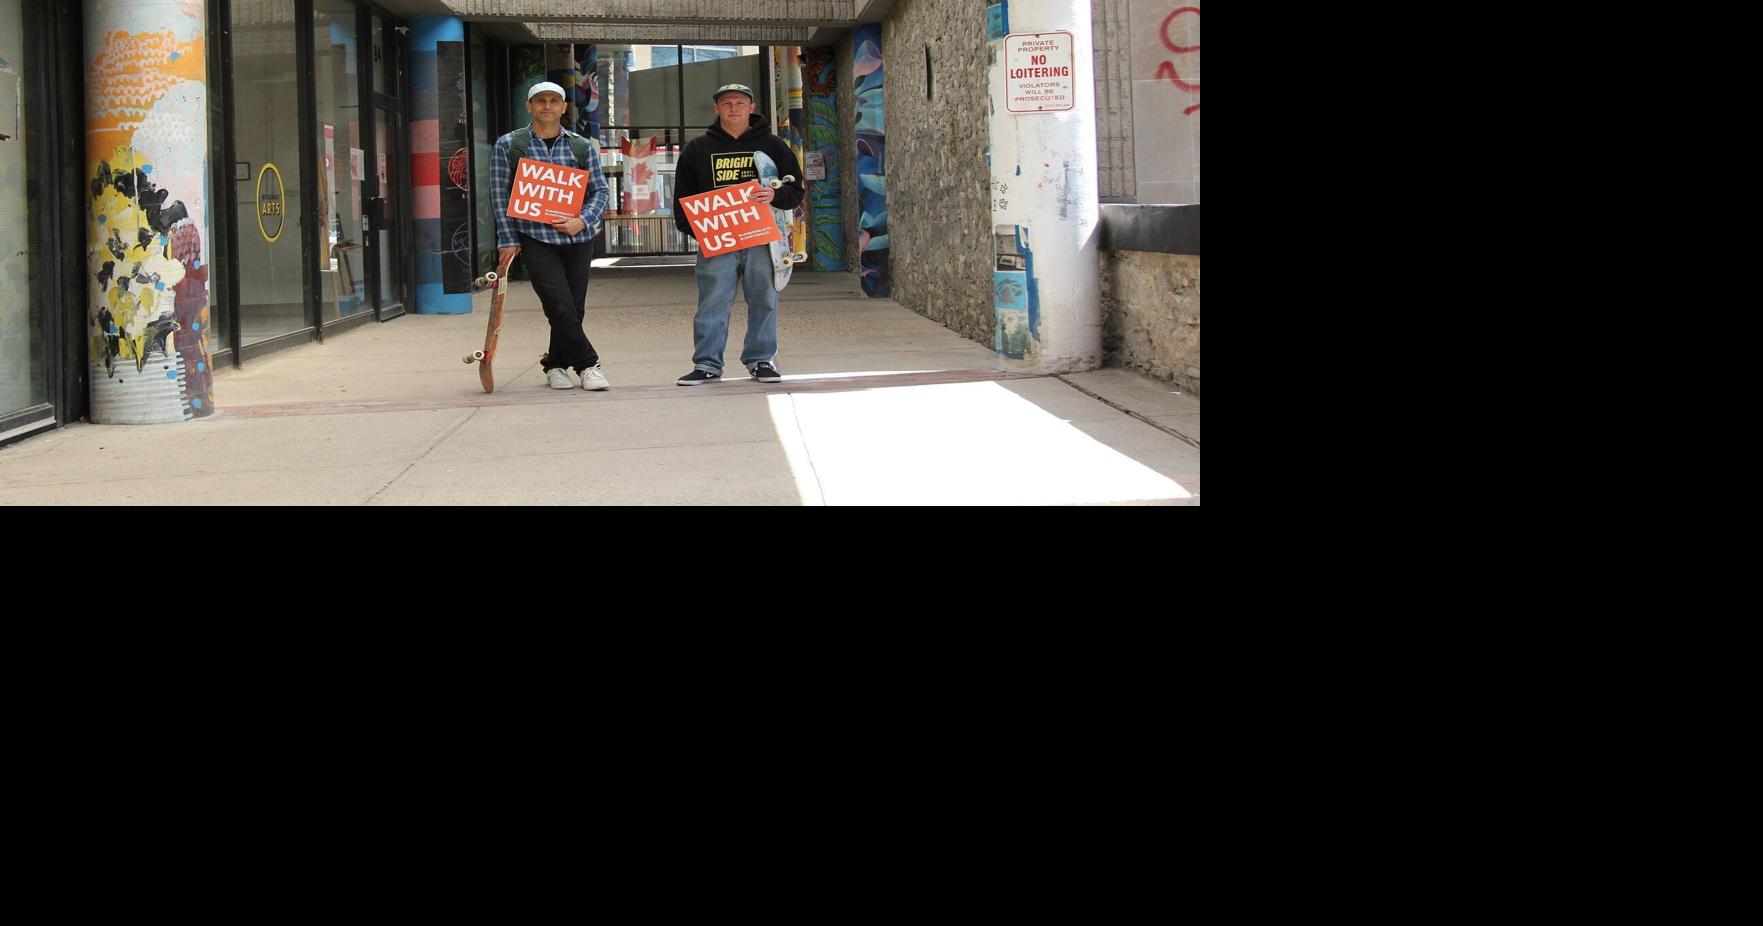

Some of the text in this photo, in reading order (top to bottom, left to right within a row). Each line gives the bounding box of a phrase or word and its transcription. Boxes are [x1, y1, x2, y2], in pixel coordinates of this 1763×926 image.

[1031, 55, 1046, 65] NO
[1010, 67, 1068, 78] LOITERING
[715, 156, 754, 170] BRIGHT
[521, 162, 585, 189] WALK
[716, 169, 740, 182] SIDE
[518, 180, 574, 205] WITH
[684, 185, 755, 216] WALK
[262, 202, 281, 216] ARTS
[513, 198, 542, 217] US
[693, 205, 761, 234] WITH
[703, 231, 737, 252] US
